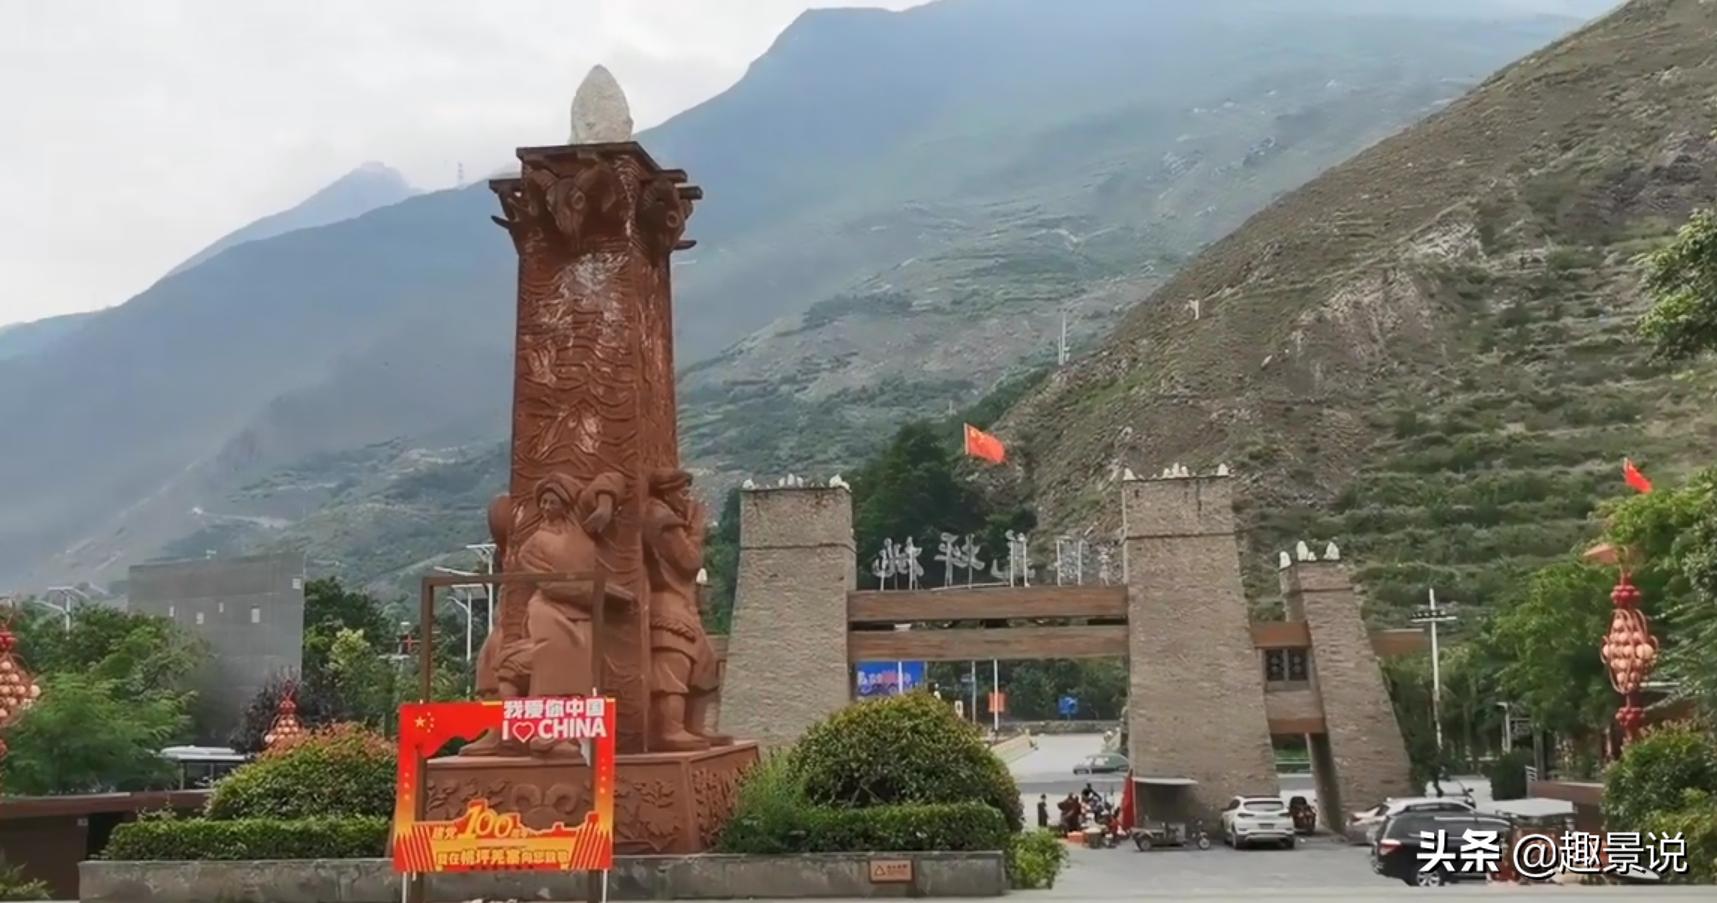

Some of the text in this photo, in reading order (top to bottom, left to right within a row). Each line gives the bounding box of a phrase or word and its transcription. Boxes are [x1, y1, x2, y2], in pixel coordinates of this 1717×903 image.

[503, 698, 605, 719] 我爱你中国
[502, 717, 607, 740] I CHINA
